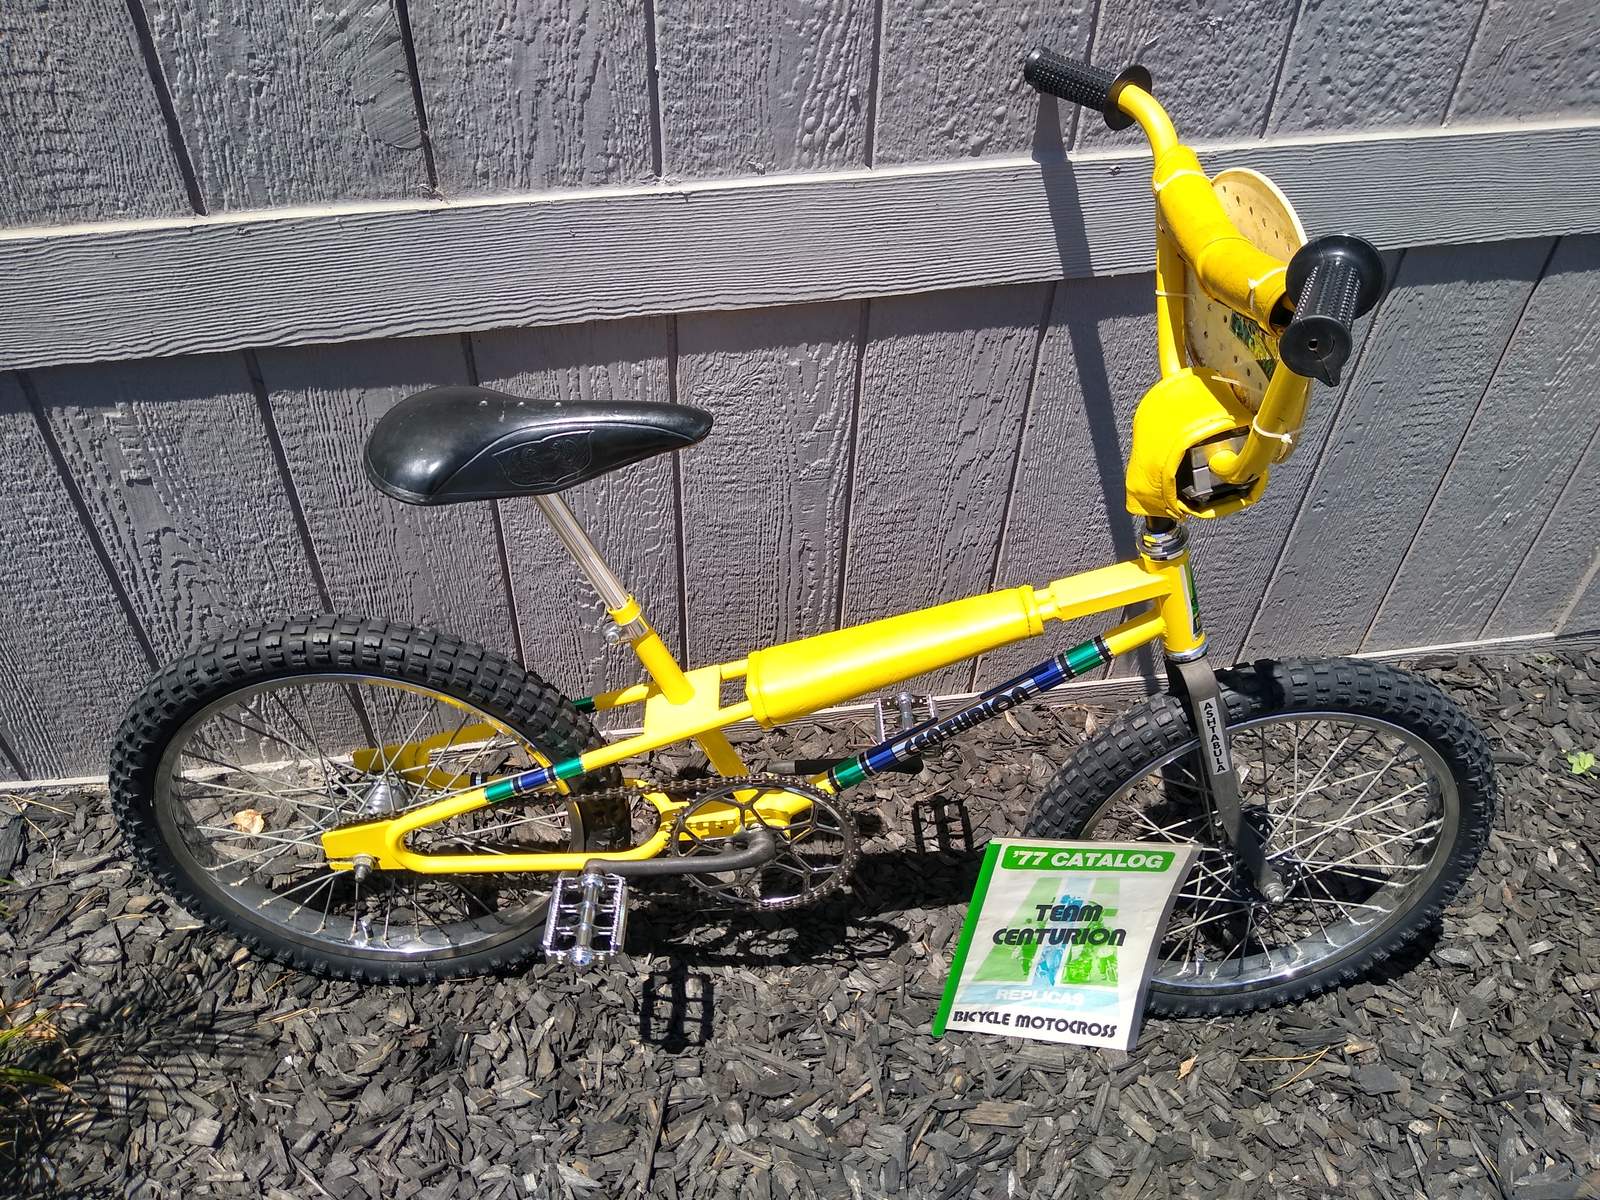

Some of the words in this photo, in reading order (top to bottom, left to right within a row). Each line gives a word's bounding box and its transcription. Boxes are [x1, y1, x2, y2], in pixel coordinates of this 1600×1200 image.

[904, 685, 1032, 755] CENTURION
[1203, 702, 1227, 773] ASHTABULA
[1050, 852, 1164, 869] CATALOG
[1035, 904, 1103, 922] TEAM
[993, 928, 1127, 947] CENTURION
[996, 989, 1084, 1005] REPLICAS
[952, 1010, 1011, 1025] BICYCLE
[1014, 1014, 1117, 1038] MOTOCROSS
